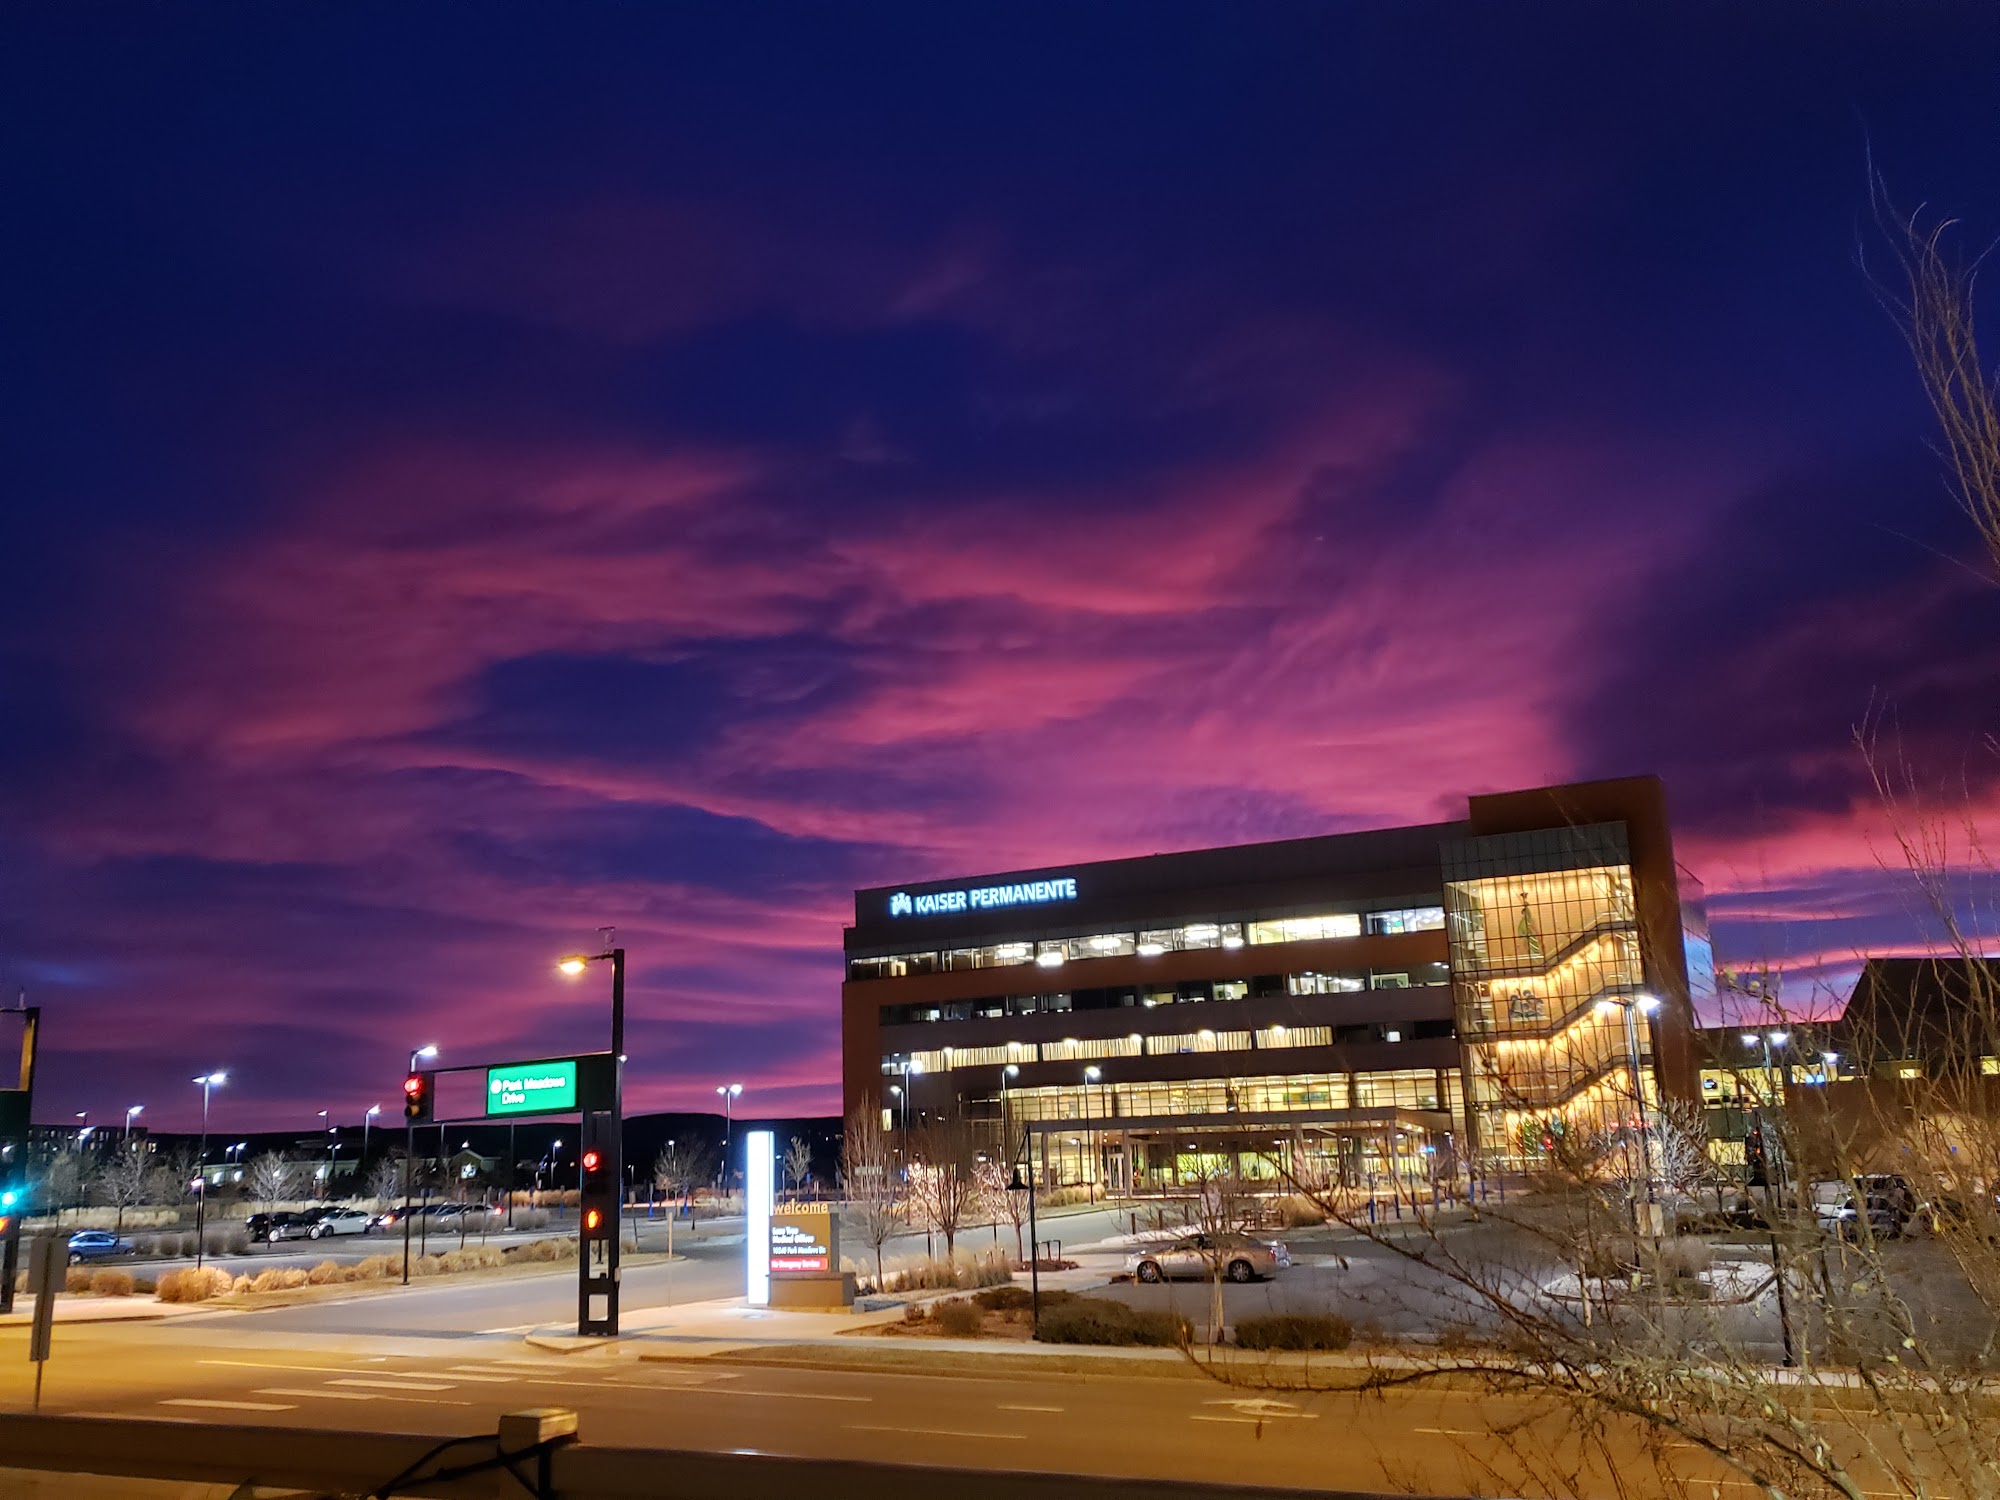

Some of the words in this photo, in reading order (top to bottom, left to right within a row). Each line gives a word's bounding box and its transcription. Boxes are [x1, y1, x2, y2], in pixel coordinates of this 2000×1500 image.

[915, 891, 967, 914] KAISER
[970, 878, 1077, 908] PERMANENTE
[502, 1080, 523, 1092] Park
[523, 1076, 566, 1090] Meadows
[501, 1092, 526, 1105] Drive
[774, 1198, 829, 1214] welcome
